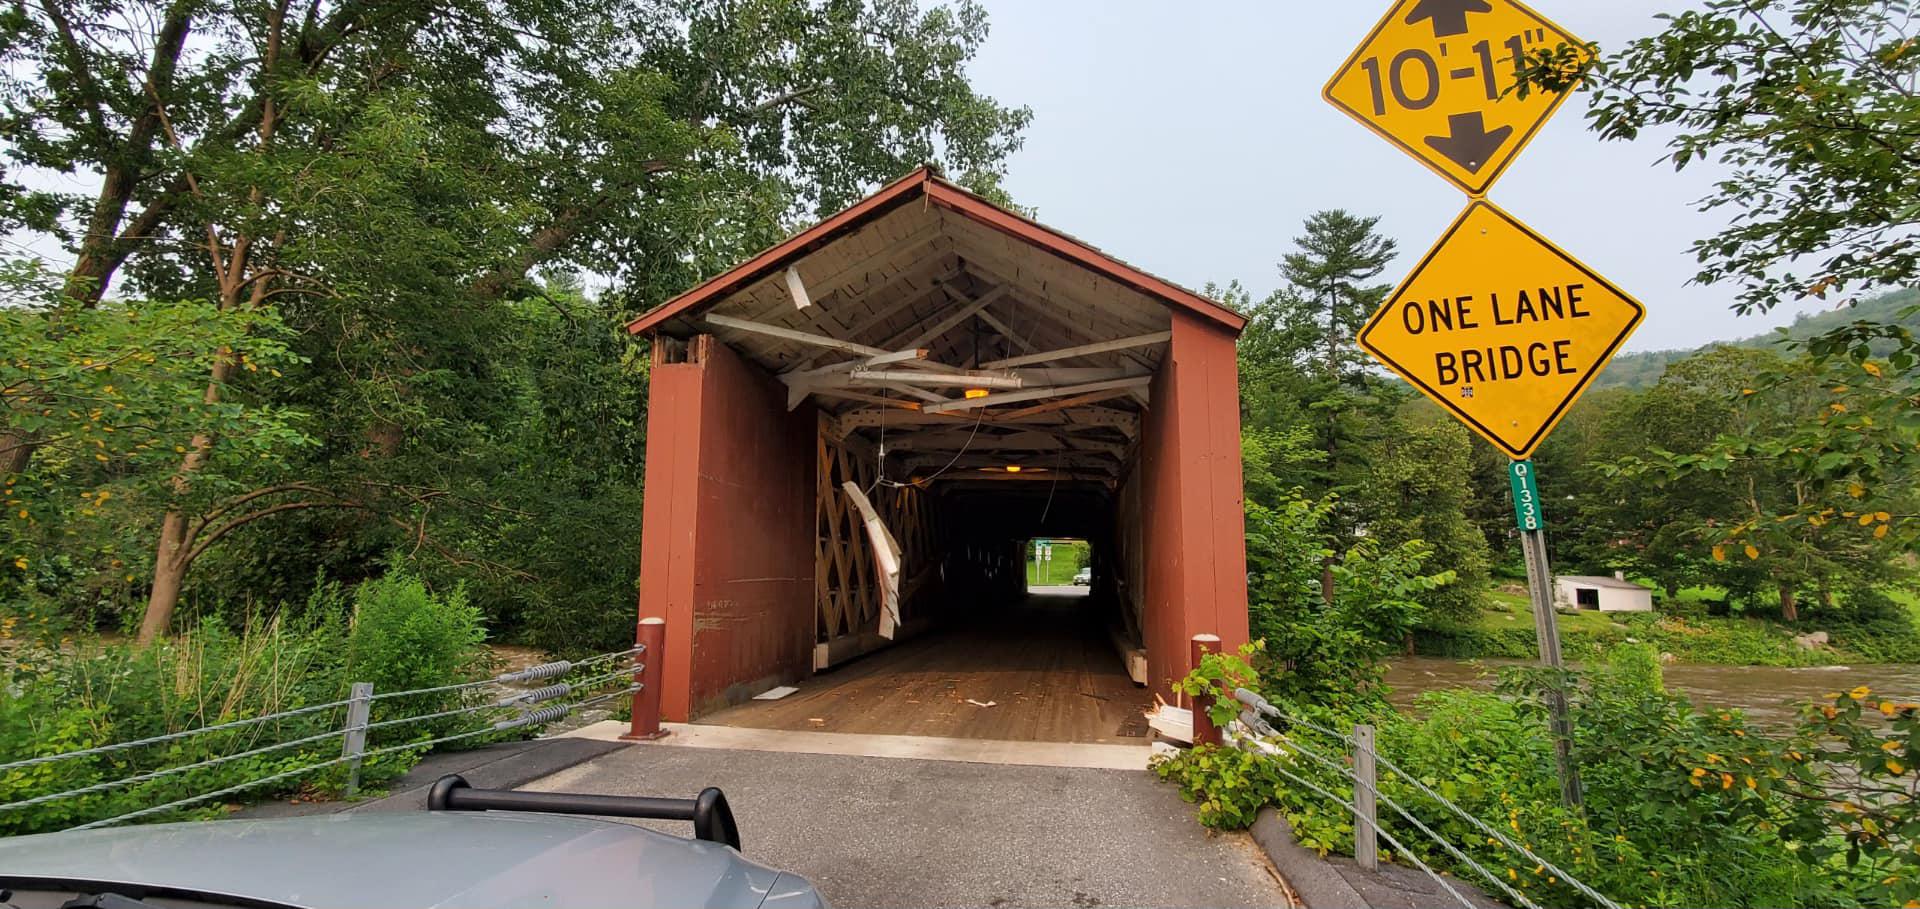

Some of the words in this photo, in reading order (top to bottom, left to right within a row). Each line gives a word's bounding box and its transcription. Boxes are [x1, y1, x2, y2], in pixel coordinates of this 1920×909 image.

[1402, 296, 1478, 335] ONE
[1490, 284, 1590, 325] LANE
[1435, 340, 1577, 386] BRIDGE
